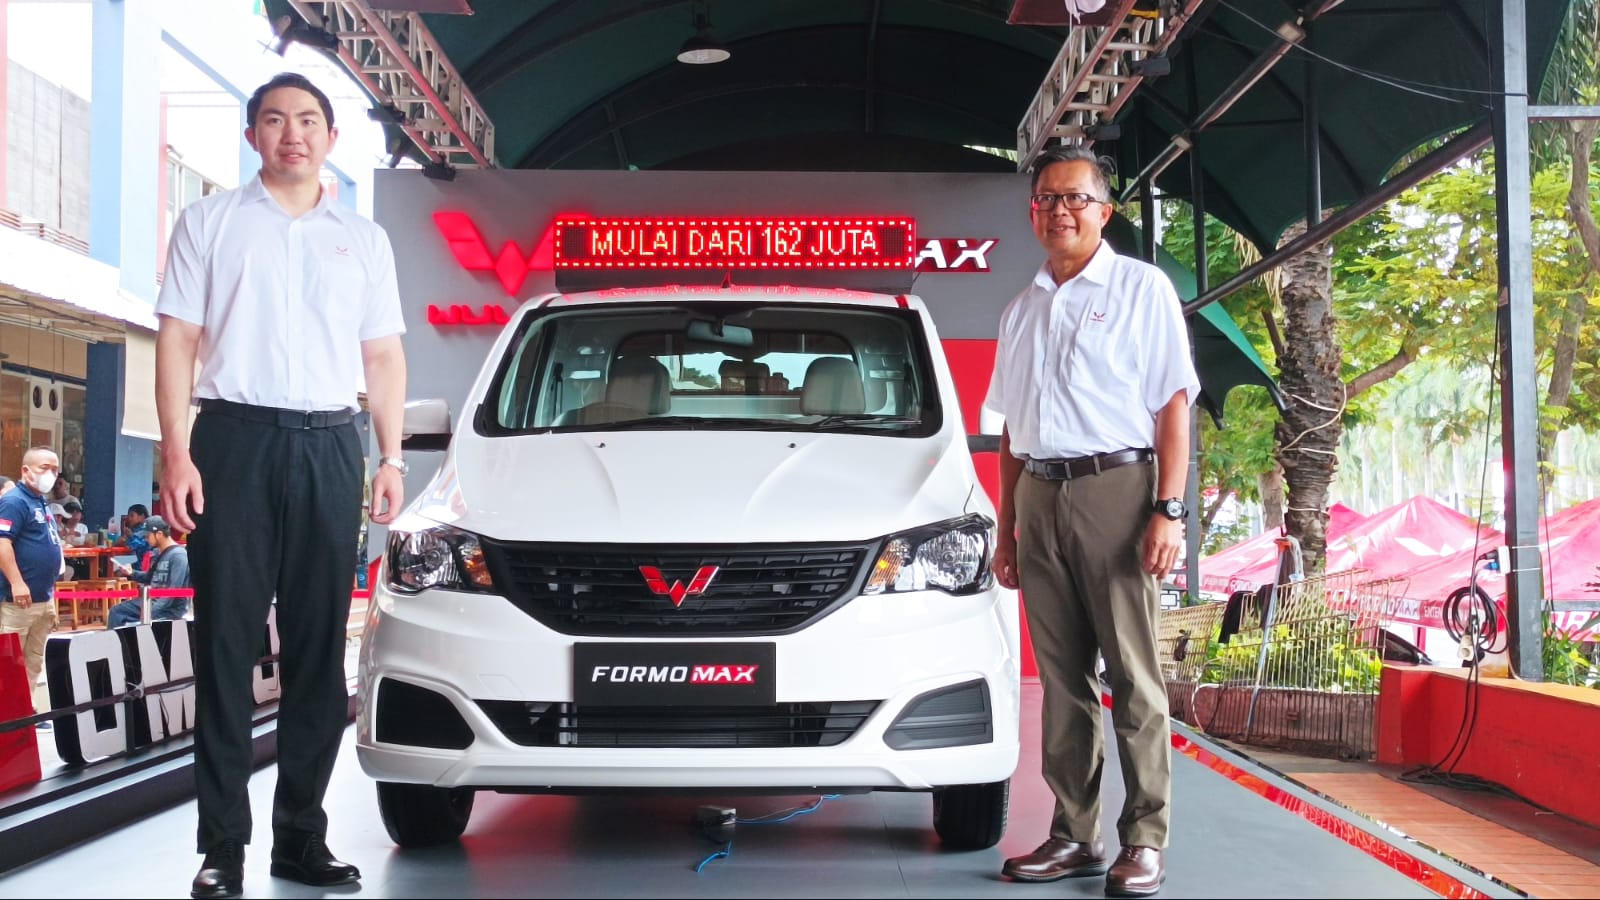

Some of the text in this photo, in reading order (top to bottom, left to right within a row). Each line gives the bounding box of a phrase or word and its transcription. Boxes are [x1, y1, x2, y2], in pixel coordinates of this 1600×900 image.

[592, 227, 879, 255] MULAI DARI 162 JUTA
[915, 240, 995, 268] AX
[592, 666, 755, 682] FORMO MAX
